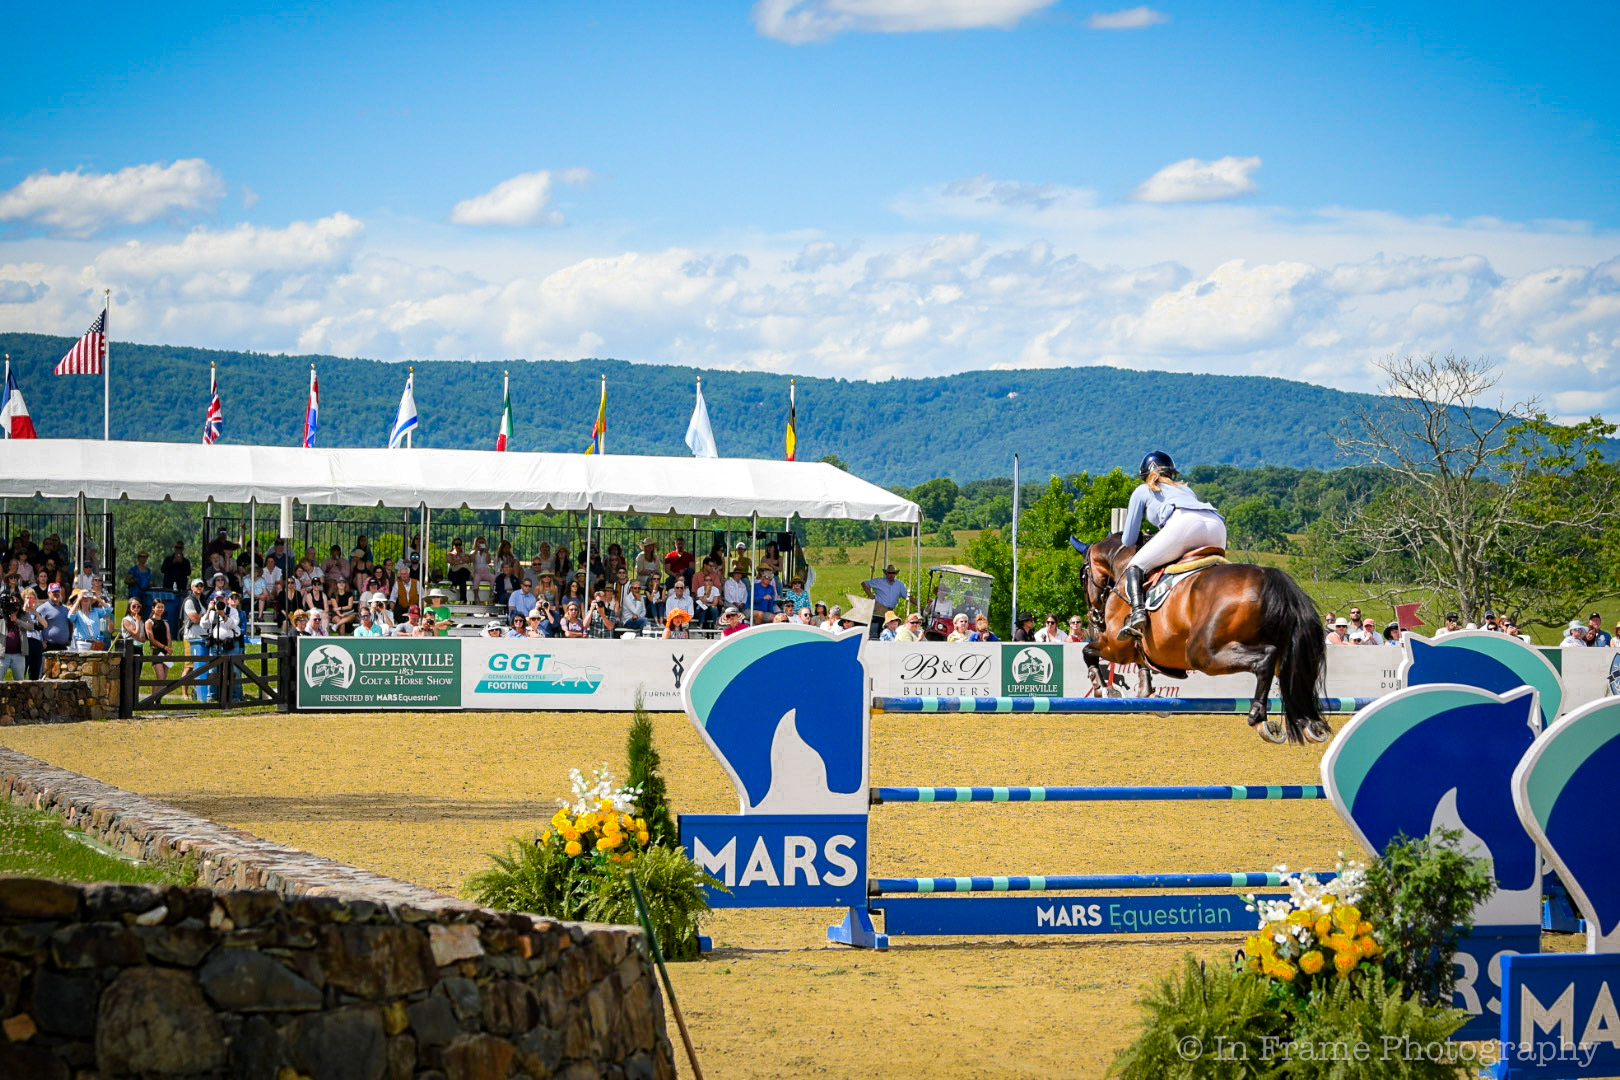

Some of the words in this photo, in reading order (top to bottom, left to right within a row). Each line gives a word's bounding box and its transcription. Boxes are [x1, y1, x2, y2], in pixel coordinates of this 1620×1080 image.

[359, 653, 454, 666] UPPERVILLE
[488, 653, 552, 671] GGT
[360, 675, 383, 685] COLT
[394, 675, 423, 685] HORSE
[427, 675, 453, 685] SHOW
[487, 682, 528, 690] FOOTING
[903, 687, 990, 696] BUILDERS
[1007, 684, 1058, 692] UPPERVILLE
[376, 693, 398, 701] MARS
[694, 834, 858, 887] MARS
[1036, 904, 1103, 927] MARS
[1109, 903, 1231, 932] Equestrian
[1520, 980, 1620, 1052] MA
